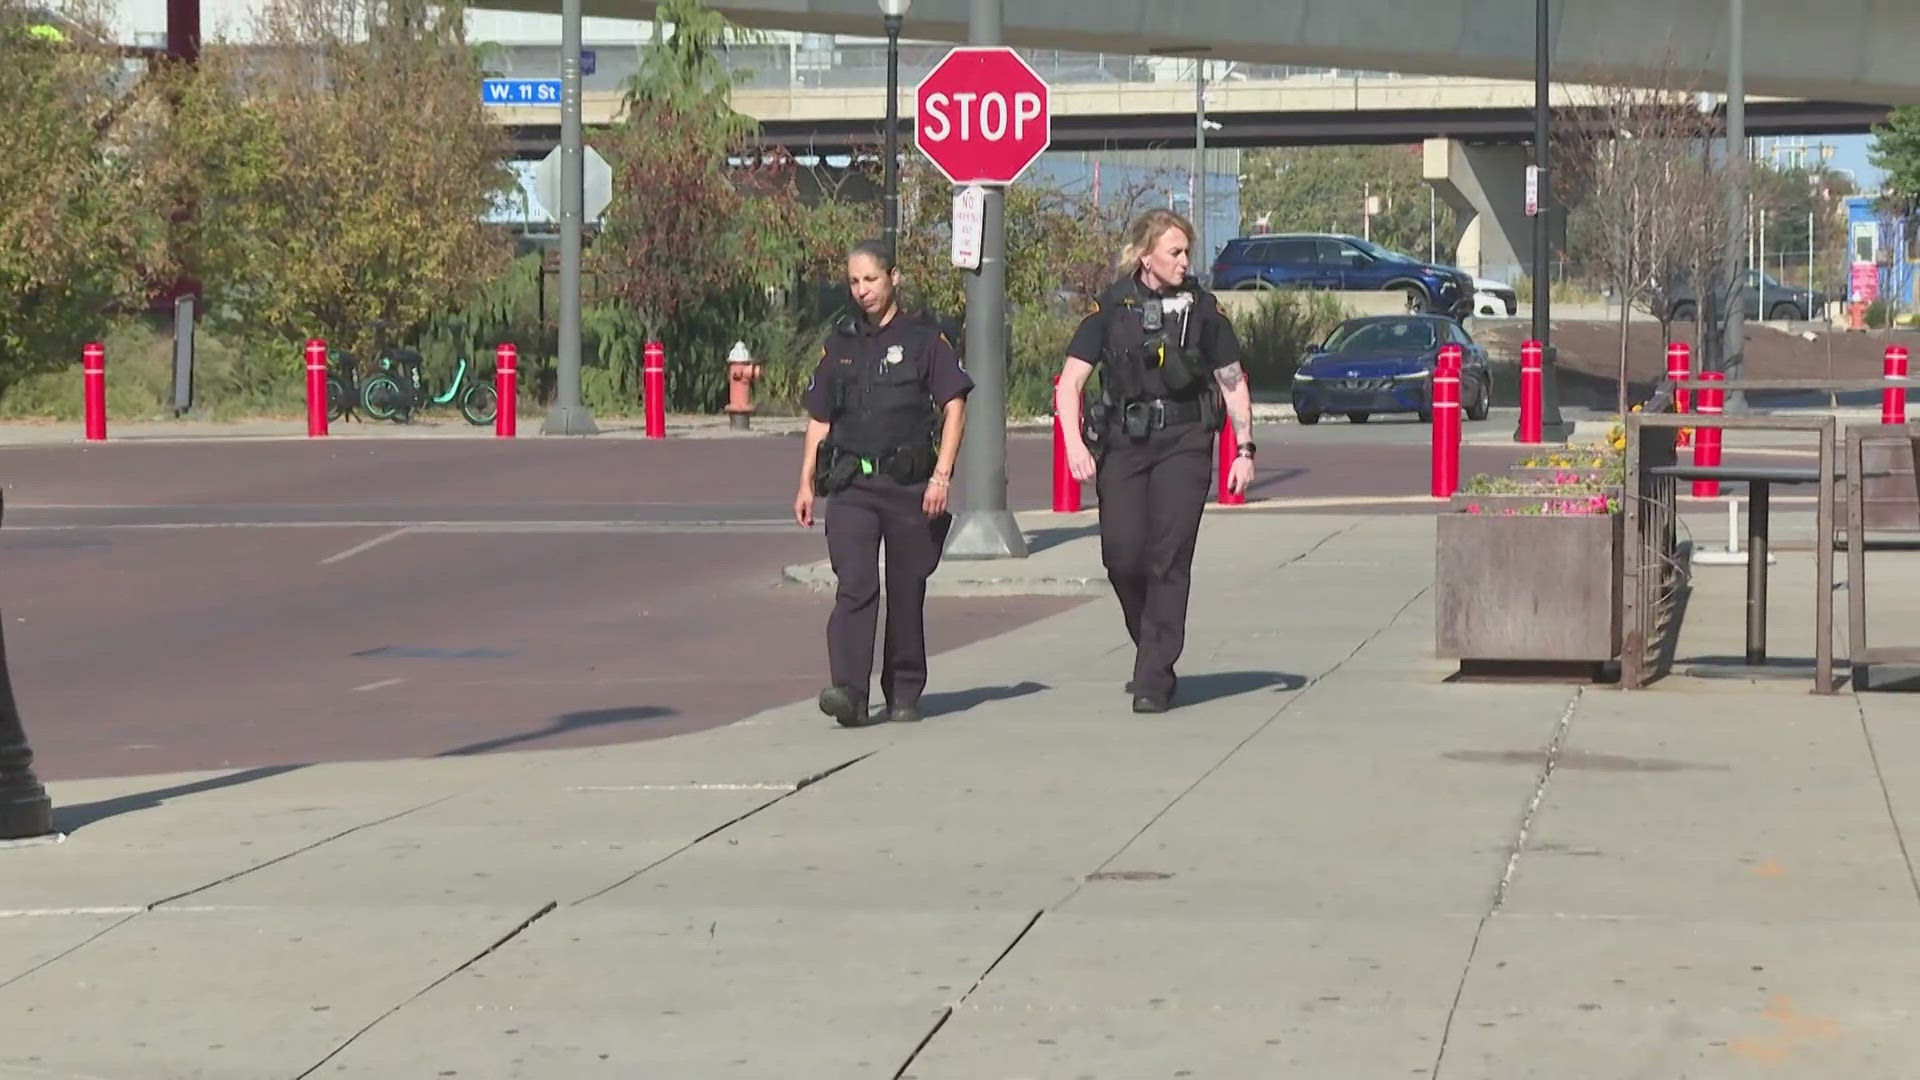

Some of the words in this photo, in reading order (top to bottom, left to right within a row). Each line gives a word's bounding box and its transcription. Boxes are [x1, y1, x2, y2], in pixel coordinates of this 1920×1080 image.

[490, 84, 513, 100] W.
[519, 84, 532, 100] 11
[537, 84, 556, 100] St
[924, 91, 1042, 142] STOP
[962, 195, 974, 210] NO
